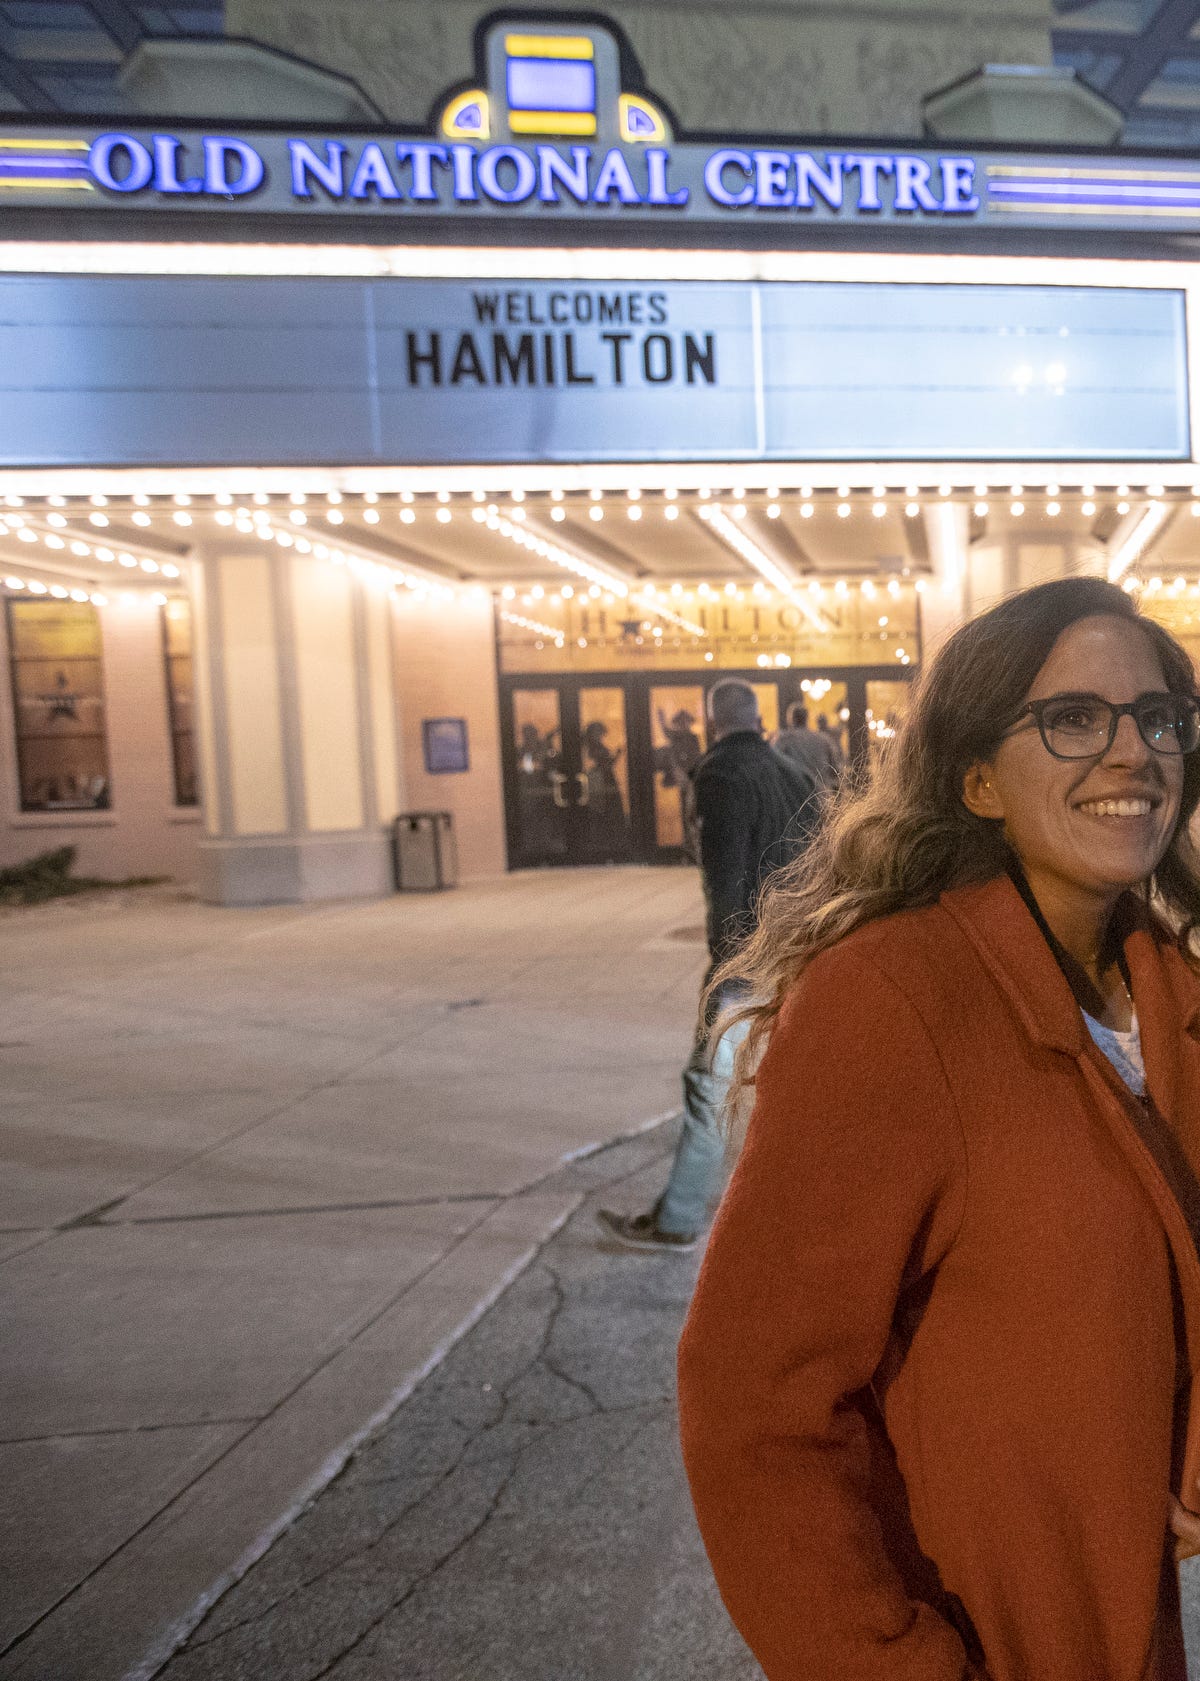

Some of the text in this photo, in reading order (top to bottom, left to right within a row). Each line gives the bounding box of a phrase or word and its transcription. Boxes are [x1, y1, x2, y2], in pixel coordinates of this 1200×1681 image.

[87, 132, 980, 213] OLD NATIONAL CENTRE
[472, 290, 668, 325] WELCOMES
[405, 330, 717, 387] HAMILTON
[580, 604, 845, 635] HMILTON
